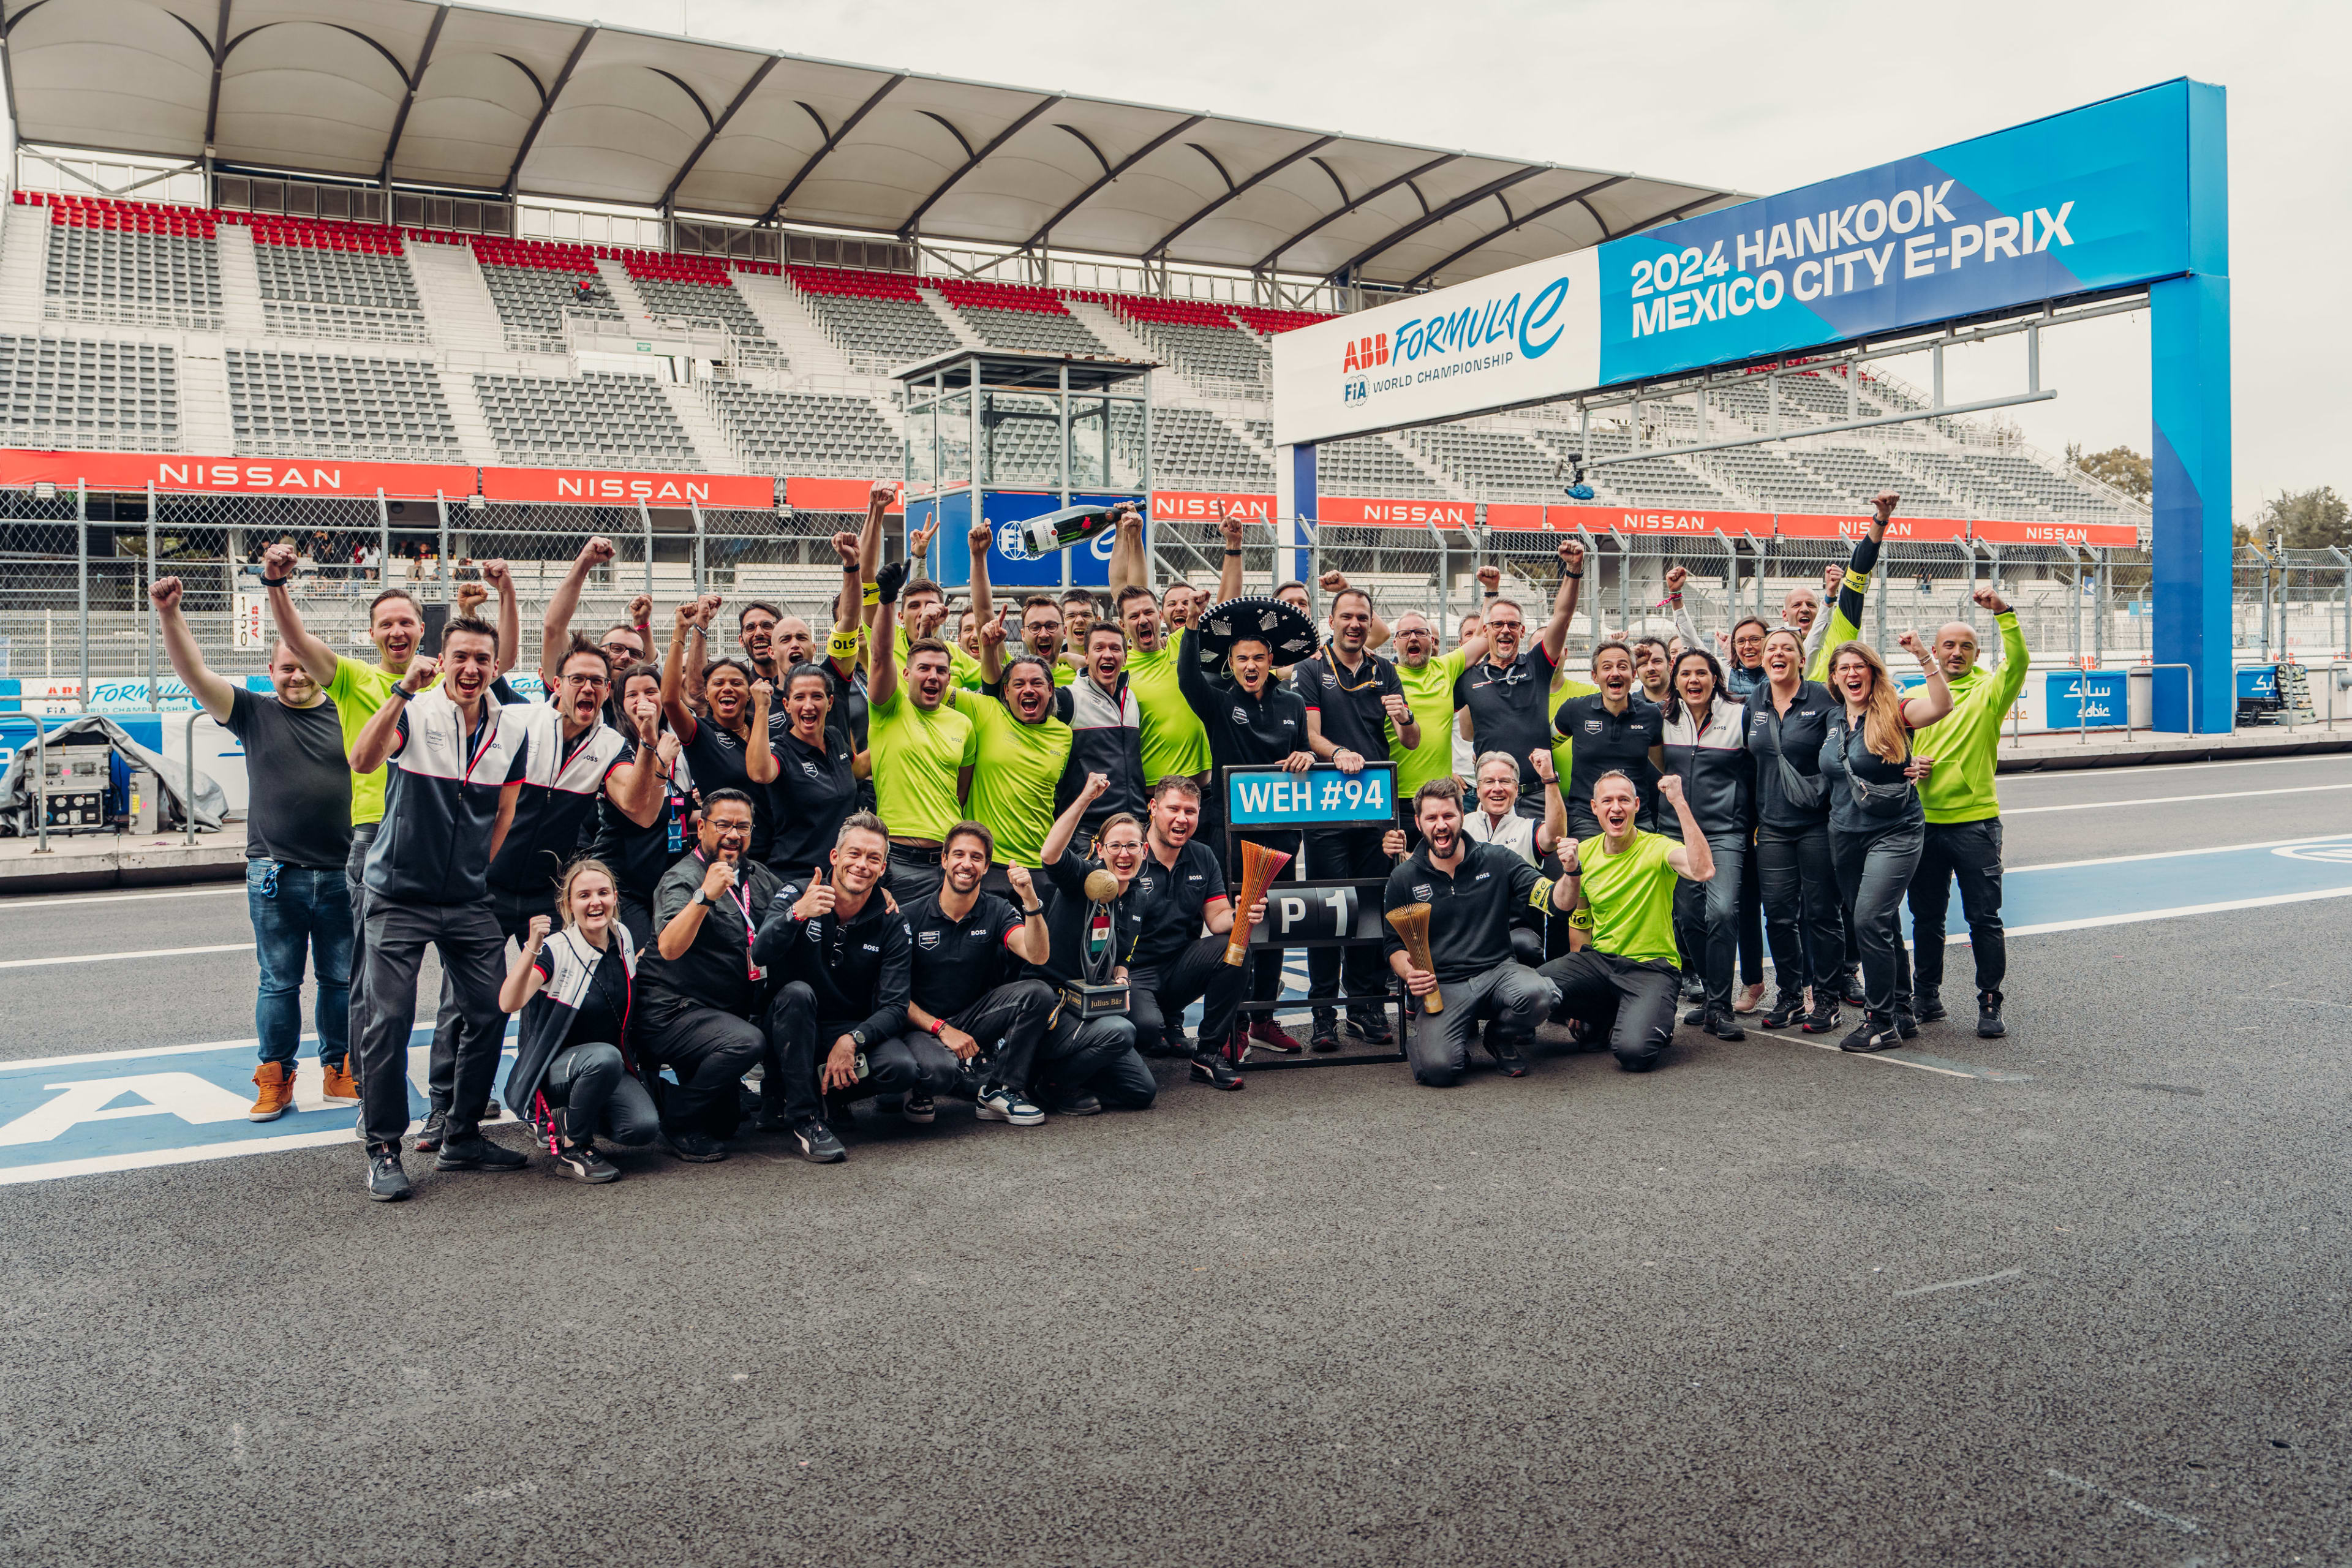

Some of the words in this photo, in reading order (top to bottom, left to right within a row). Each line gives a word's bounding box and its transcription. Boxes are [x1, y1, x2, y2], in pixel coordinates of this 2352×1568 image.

[1630, 239, 1730, 298] 2024
[1736, 179, 1956, 271] HANKOOK
[1632, 270, 1785, 339] MEXICO
[1792, 243, 1896, 301] CITY
[1904, 200, 2076, 280] E-PRIX
[1343, 333, 1389, 374] ABB
[1392, 292, 1521, 368] FORMULA
[1373, 374, 1412, 393] WORLD
[1417, 352, 1513, 384] CHAMPIONSHIP
[160, 464, 341, 489] NISSAN
[559, 478, 709, 500] NISSAN
[1156, 499, 1267, 516] NISSAN
[1365, 505, 1463, 523] NISSAN
[1624, 514, 1705, 530] NISSAN
[1839, 521, 1912, 535] NISAN
[2026, 527, 2087, 541] NISSAN
[1238, 781, 1312, 813] WEH
[1320, 779, 1384, 811] #94
[1280, 897, 1306, 933] P
[1325, 889, 1348, 937] 1
[863, 943, 879, 952] BOSS
[1091, 1000, 1109, 1009] Julius
